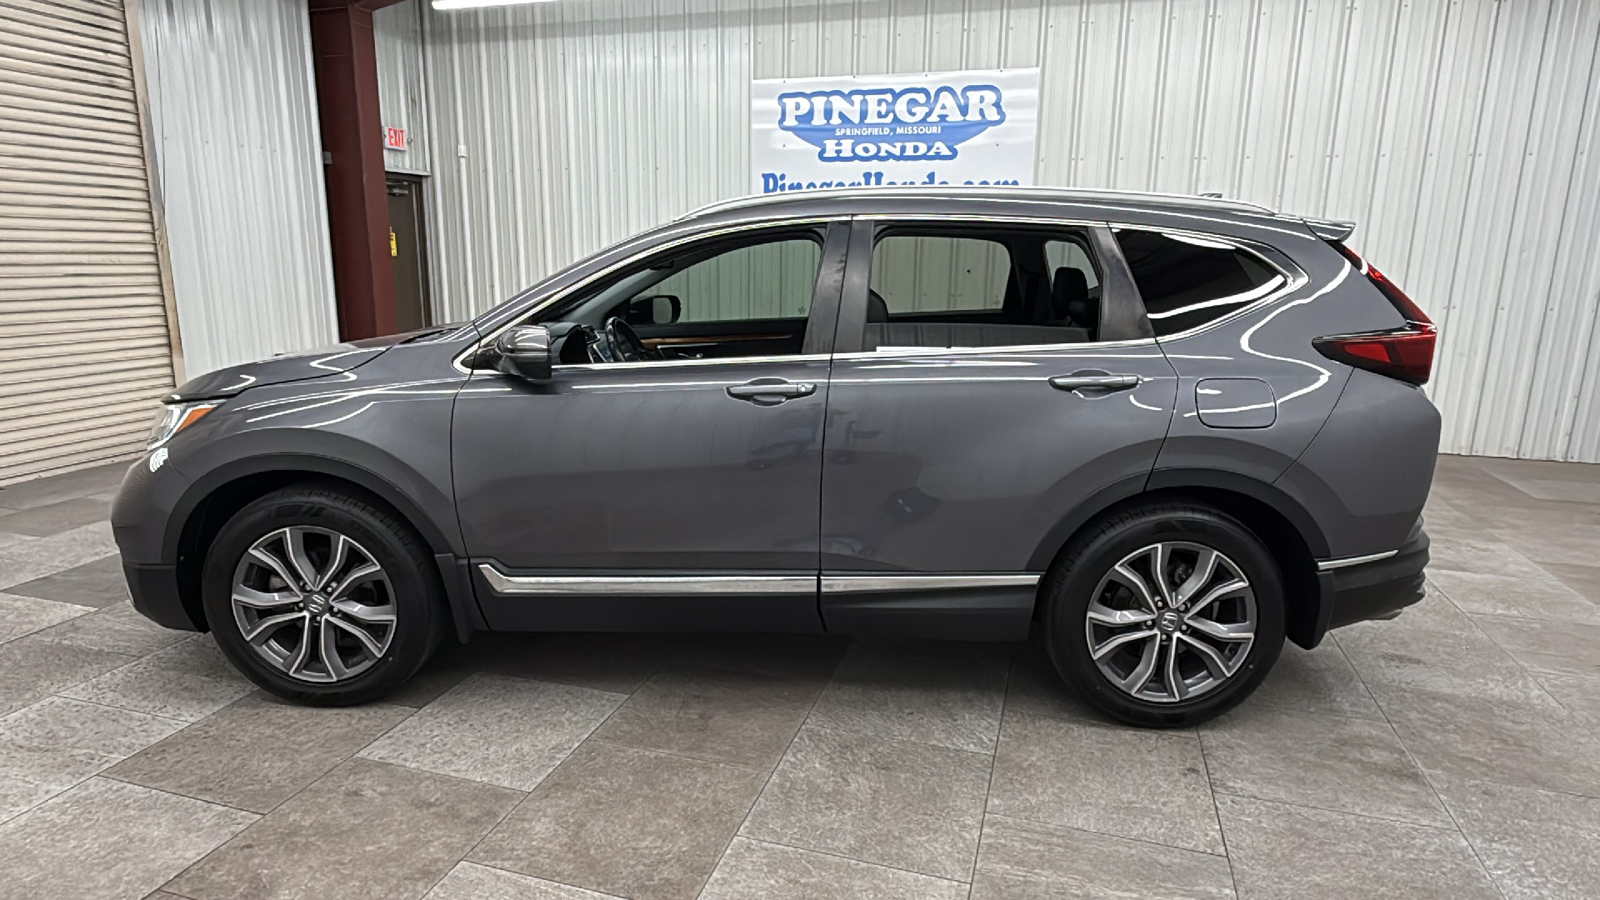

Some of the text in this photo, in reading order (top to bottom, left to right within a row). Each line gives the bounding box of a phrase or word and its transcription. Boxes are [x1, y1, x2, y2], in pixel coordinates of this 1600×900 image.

[782, 90, 1001, 126] PINEGAR
[388, 127, 405, 147] EXIT
[835, 126, 942, 136] SPRINGFIELD, MISSOURI
[822, 139, 953, 158] HONDA
